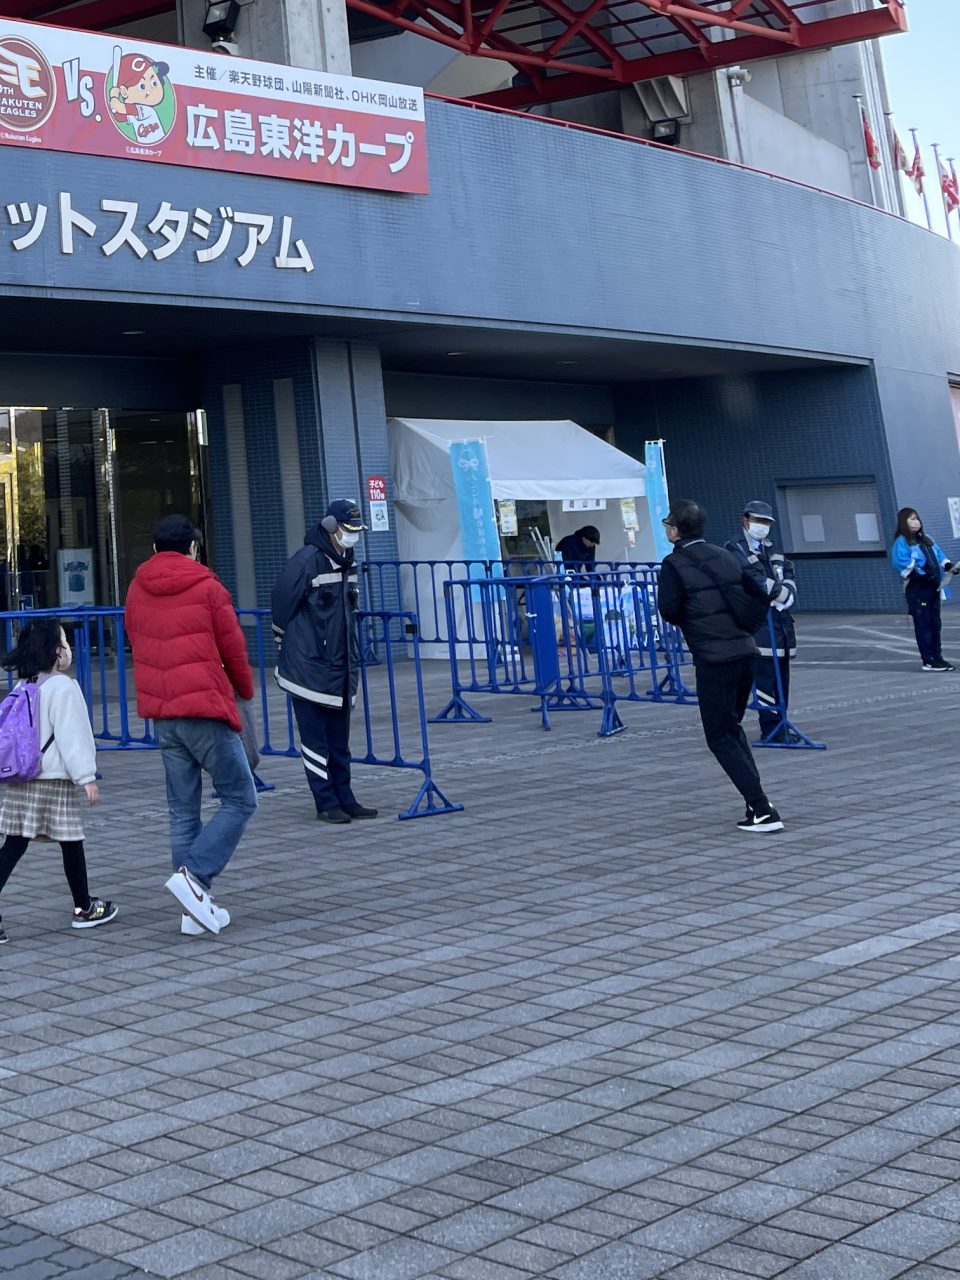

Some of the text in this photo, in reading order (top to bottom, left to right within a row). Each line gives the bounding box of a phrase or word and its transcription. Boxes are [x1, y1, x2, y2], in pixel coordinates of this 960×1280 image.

[0, 106, 37, 119] EAGLES
[186, 103, 415, 174] 広島東洋カープ
